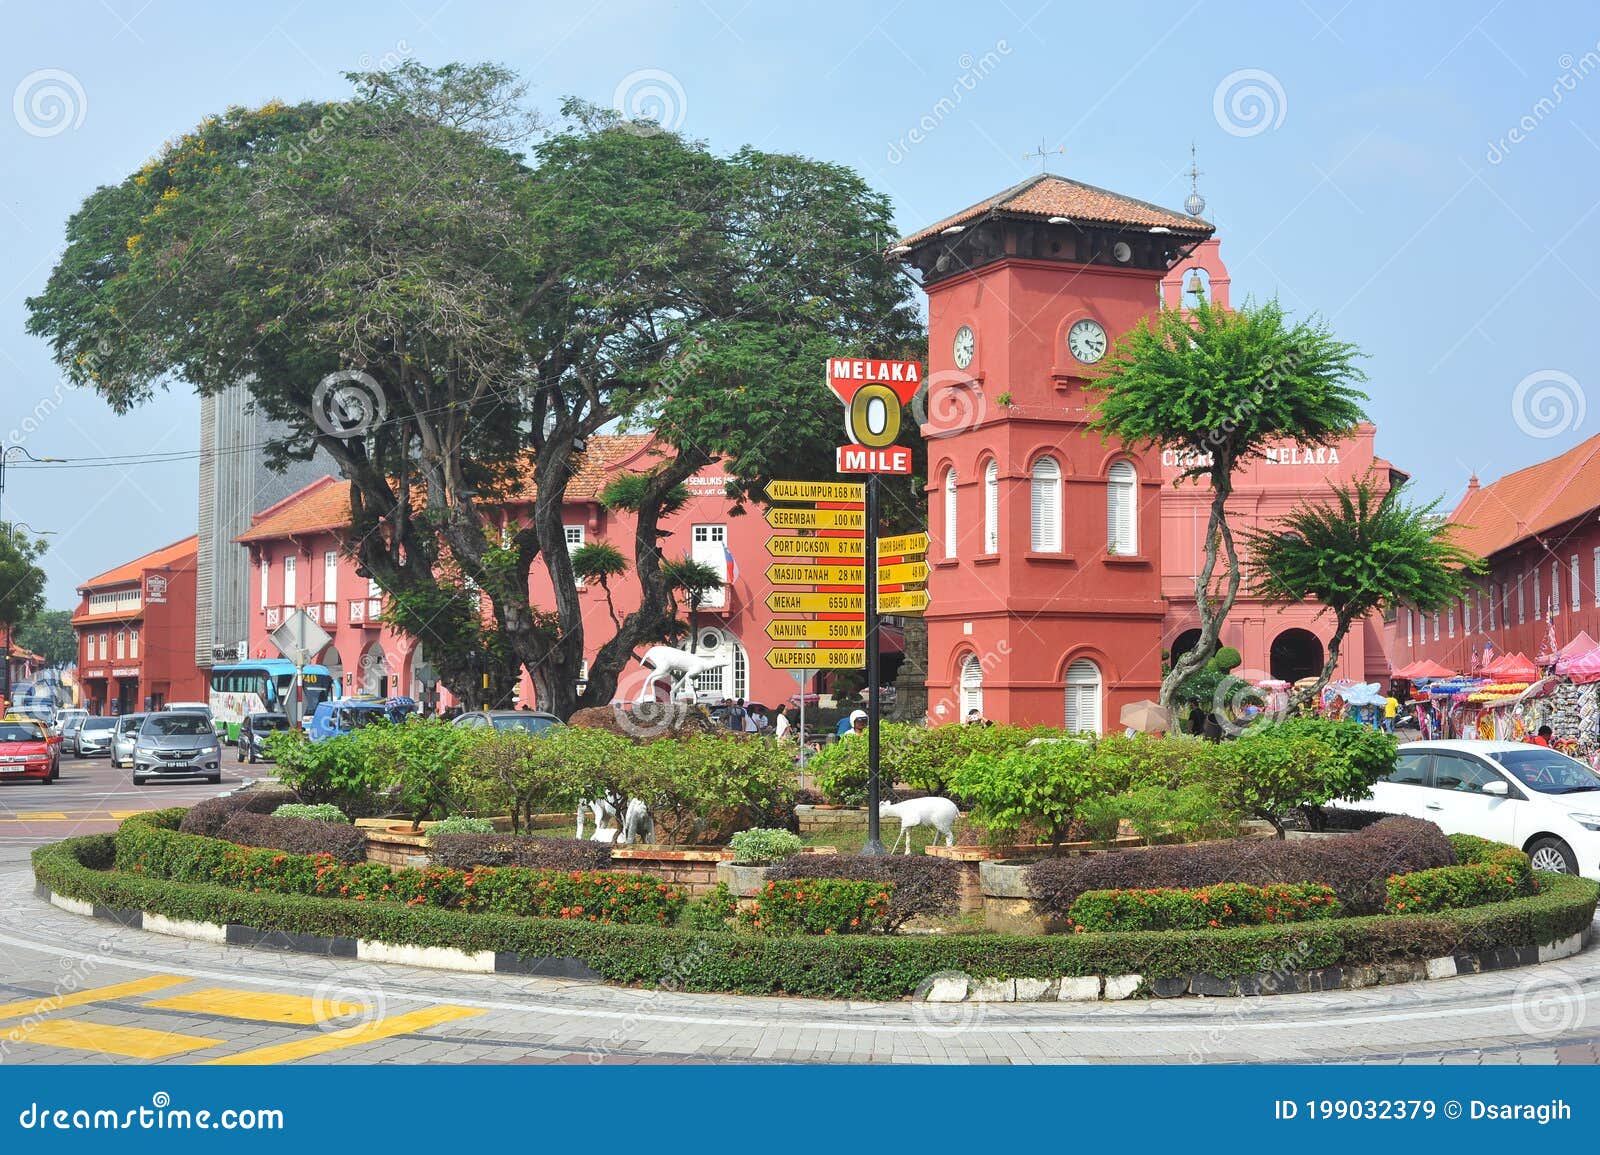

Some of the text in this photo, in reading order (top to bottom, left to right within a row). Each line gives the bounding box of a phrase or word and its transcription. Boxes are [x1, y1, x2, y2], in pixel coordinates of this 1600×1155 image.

[834, 361, 918, 382] MELAKA
[850, 383, 901, 449] 0
[845, 451, 907, 471] MILE
[1265, 448, 1340, 465] MELAKA
[773, 484, 862, 499] KUALA LUMPUR 168 KM
[774, 513, 862, 526] SEREMBAN 100 KM
[774, 540, 862, 553] PORT DICKSON 87 KM
[774, 568, 862, 581] MASJID TANAH 28 KM
[773, 596, 862, 609] MEKAH 6550 KM
[773, 625, 863, 637] NANJING 5500 KM
[774, 652, 863, 665] VALPERISO 9800 KM
